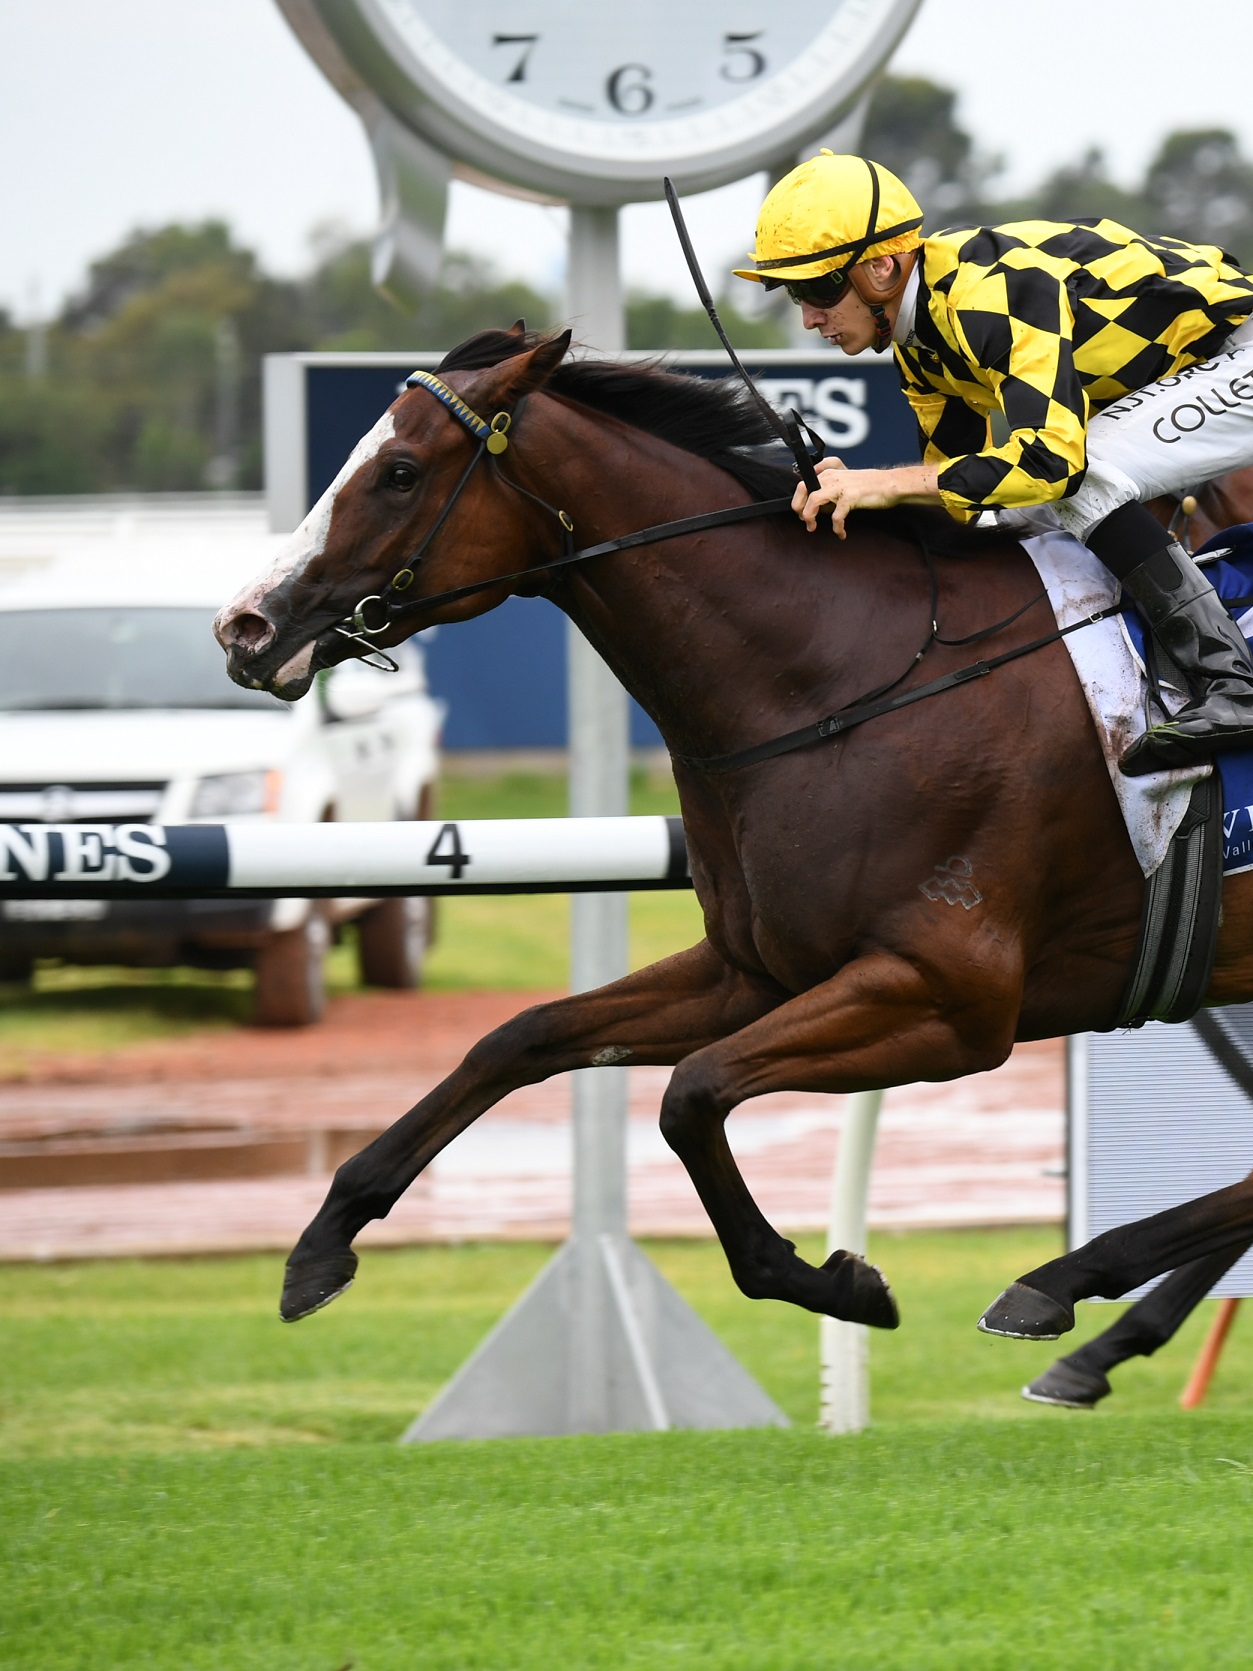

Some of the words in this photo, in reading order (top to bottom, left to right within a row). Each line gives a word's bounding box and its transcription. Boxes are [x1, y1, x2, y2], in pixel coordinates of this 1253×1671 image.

[492, 34, 541, 84] 7
[720, 30, 767, 84] 5
[605, 62, 655, 117] 6
[425, 823, 471, 879] 4
